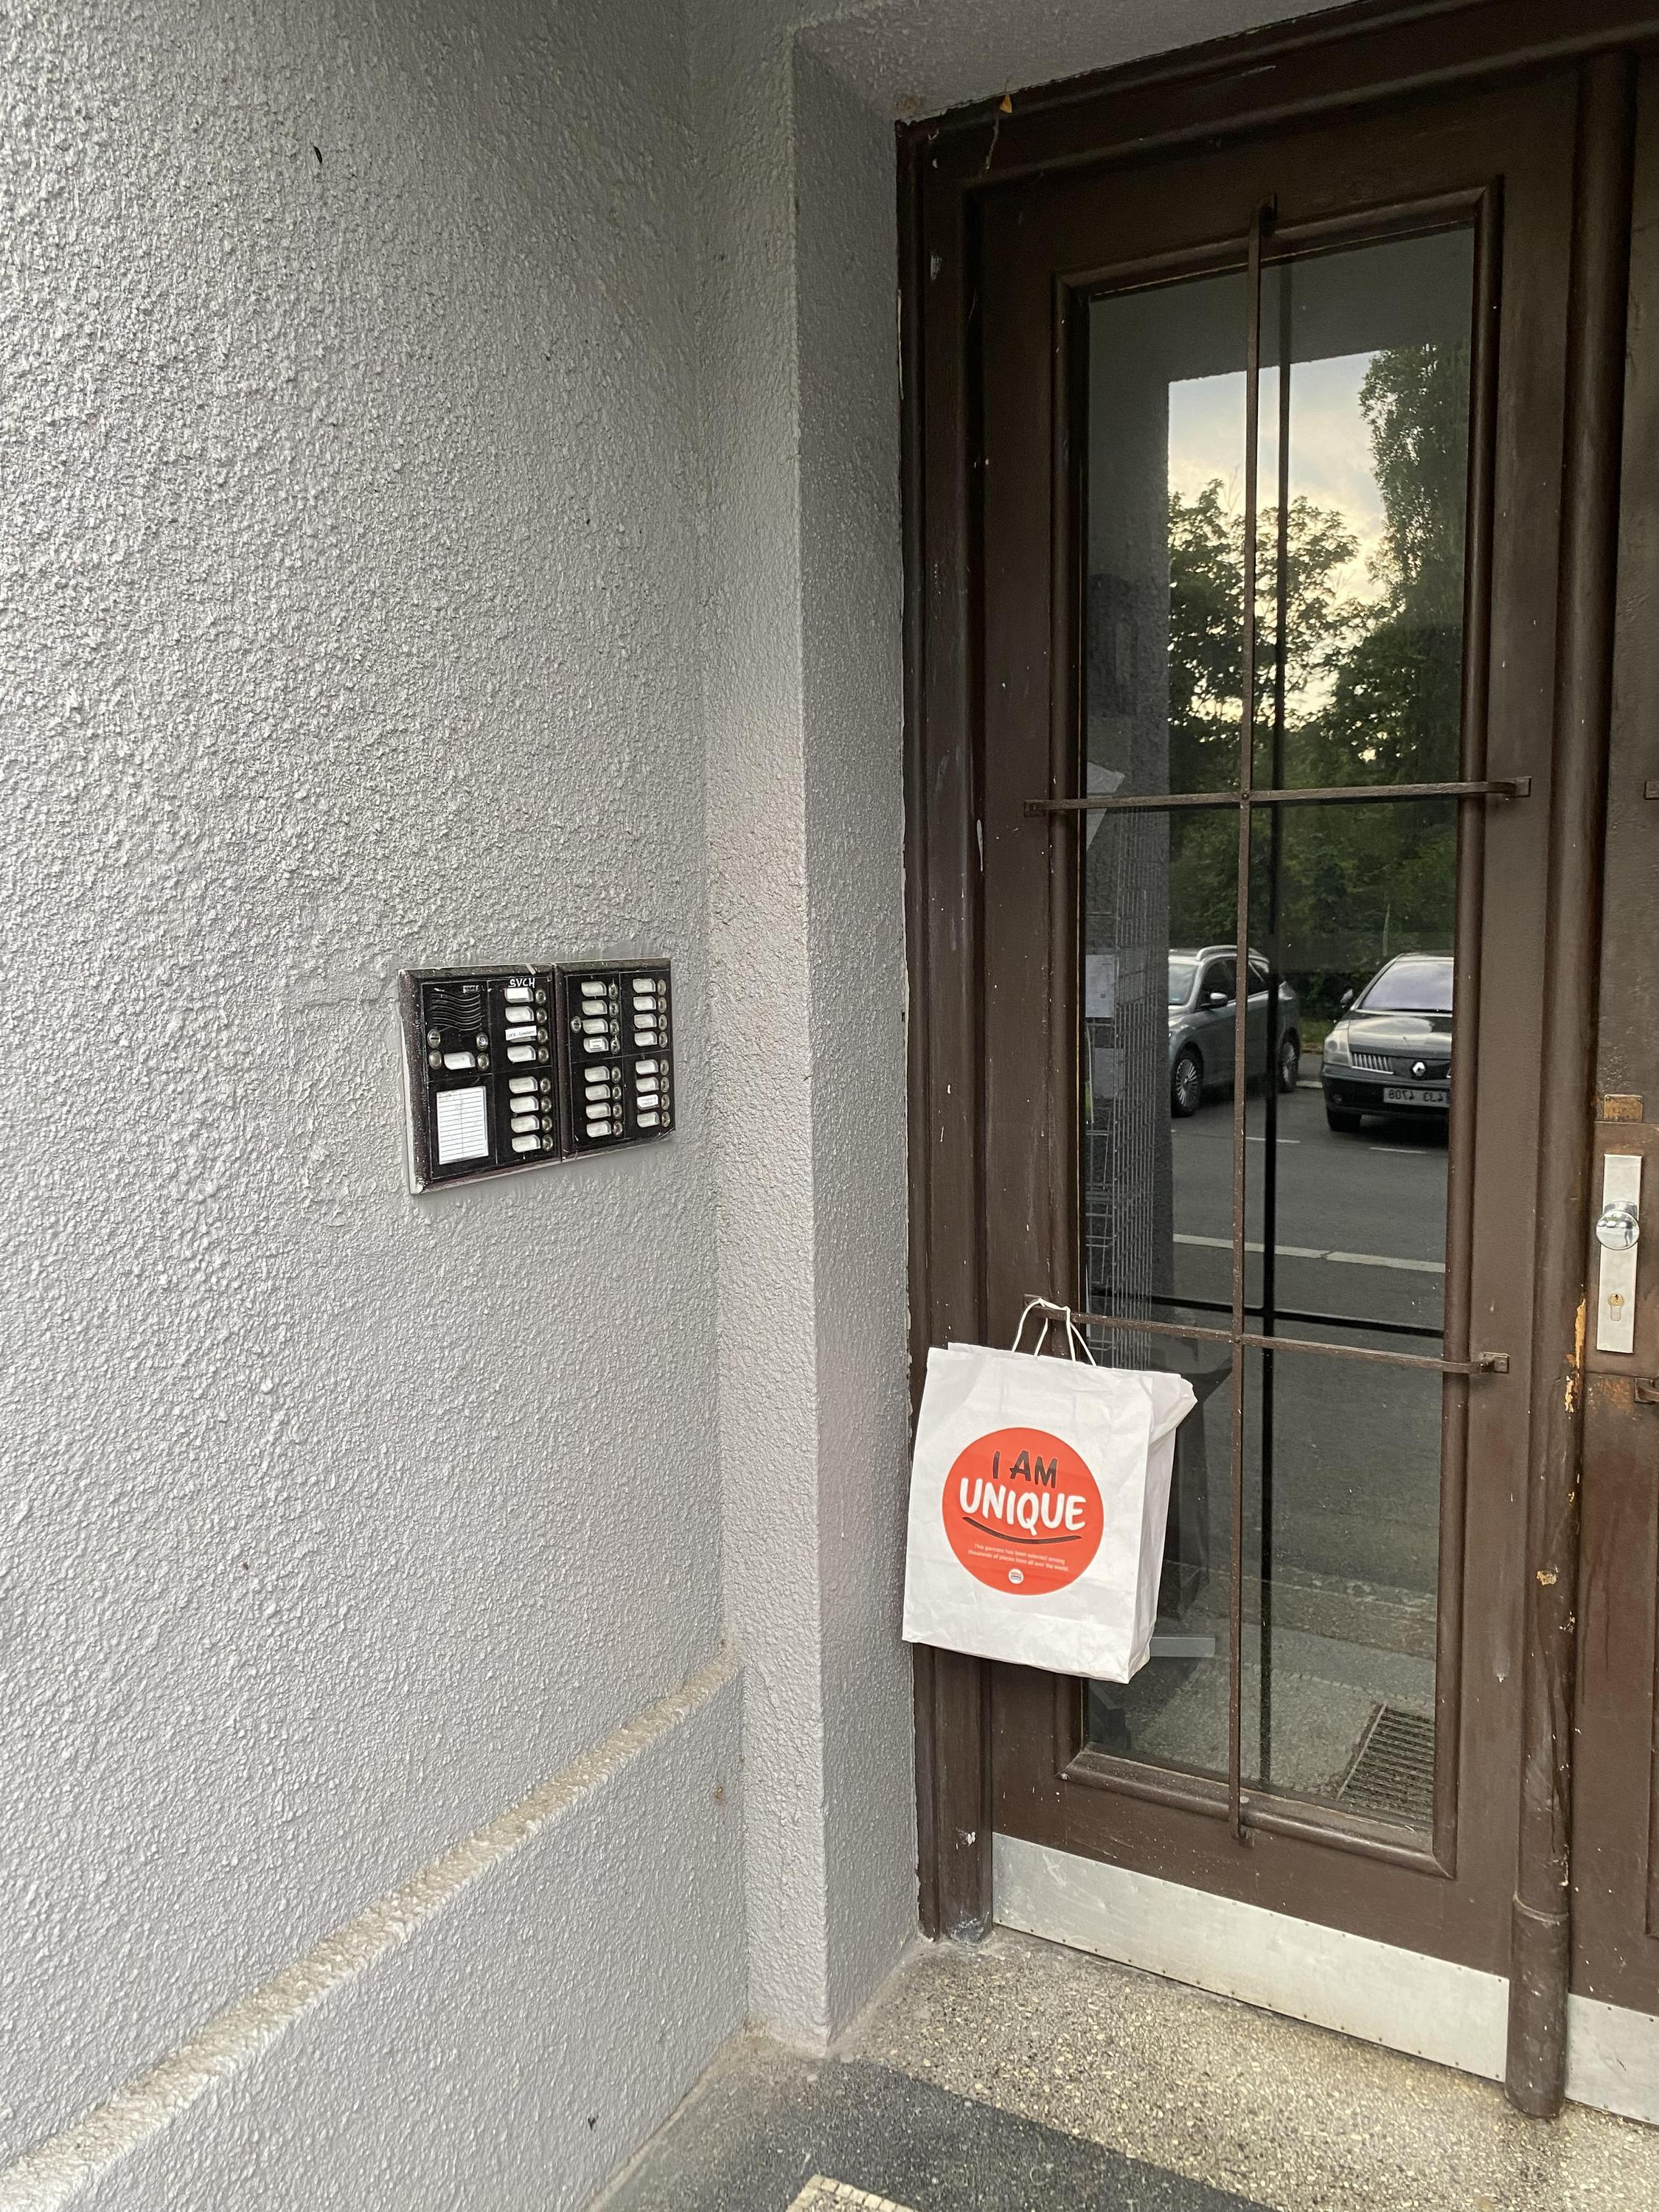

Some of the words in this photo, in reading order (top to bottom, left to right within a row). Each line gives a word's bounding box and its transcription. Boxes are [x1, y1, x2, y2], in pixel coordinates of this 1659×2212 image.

[508, 978, 535, 988] SVCH
[992, 1450, 1001, 1479] I
[1009, 1450, 1057, 1489] AM
[960, 1477, 1086, 1536] UNIQUE
[968, 1549, 992, 1559] thousands
[1015, 1557, 1027, 1565] from
[1048, 1557, 1065, 1565] among
